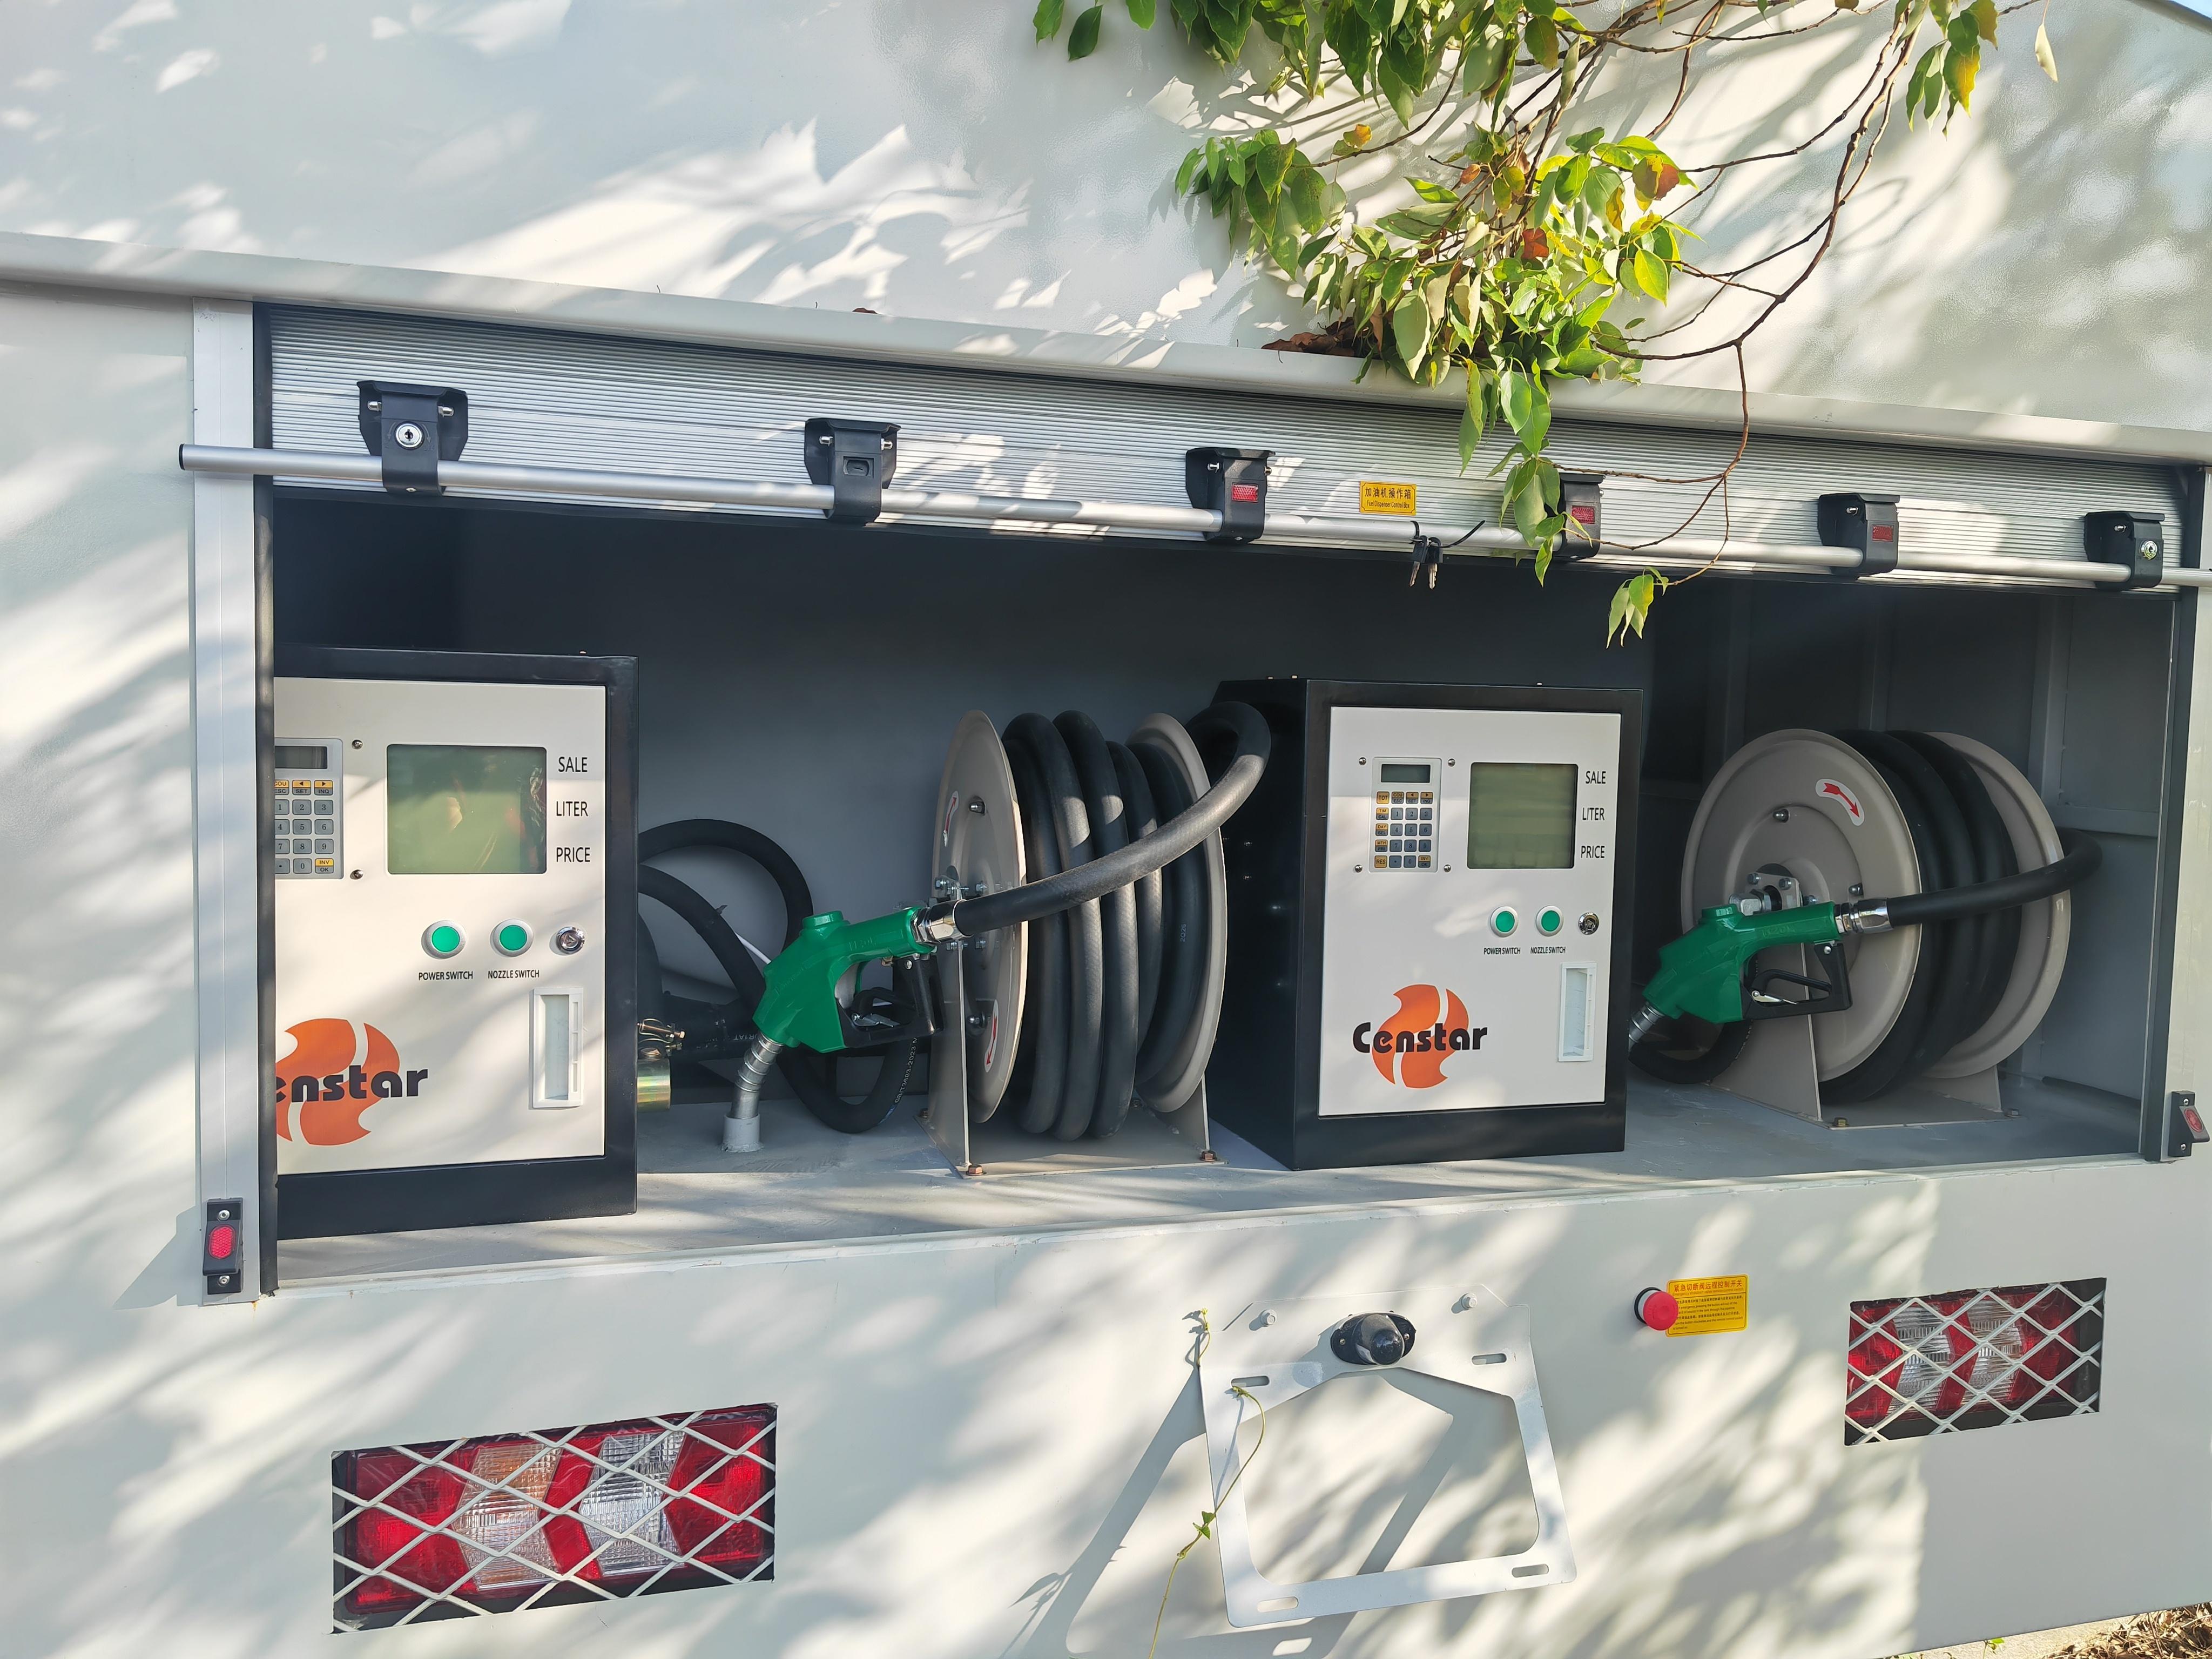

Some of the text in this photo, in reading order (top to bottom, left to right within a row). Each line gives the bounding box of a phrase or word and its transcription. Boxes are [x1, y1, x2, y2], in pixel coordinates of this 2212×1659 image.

[1365, 487, 1411, 500] 加油机操作箱
[1374, 500, 1391, 508] Dispenser
[558, 757, 588, 773] SALE
[1585, 771, 1607, 784] SALE
[556, 801, 589, 817] LITER
[1582, 807, 1605, 821] LITER
[556, 847, 591, 863] PRICE
[1581, 845, 1606, 859] PRICE
[1483, 947, 1521, 955] POWER SWITCH
[1530, 946, 1566, 955] NOZZLE SWITCH
[418, 971, 473, 981] POWER SWITCH
[487, 969, 539, 979] NOZZLE SWITCH
[1352, 1022, 1488, 1054] Censtar
[1674, 1279, 1742, 1292] 紧急切断阀远程控制开关
